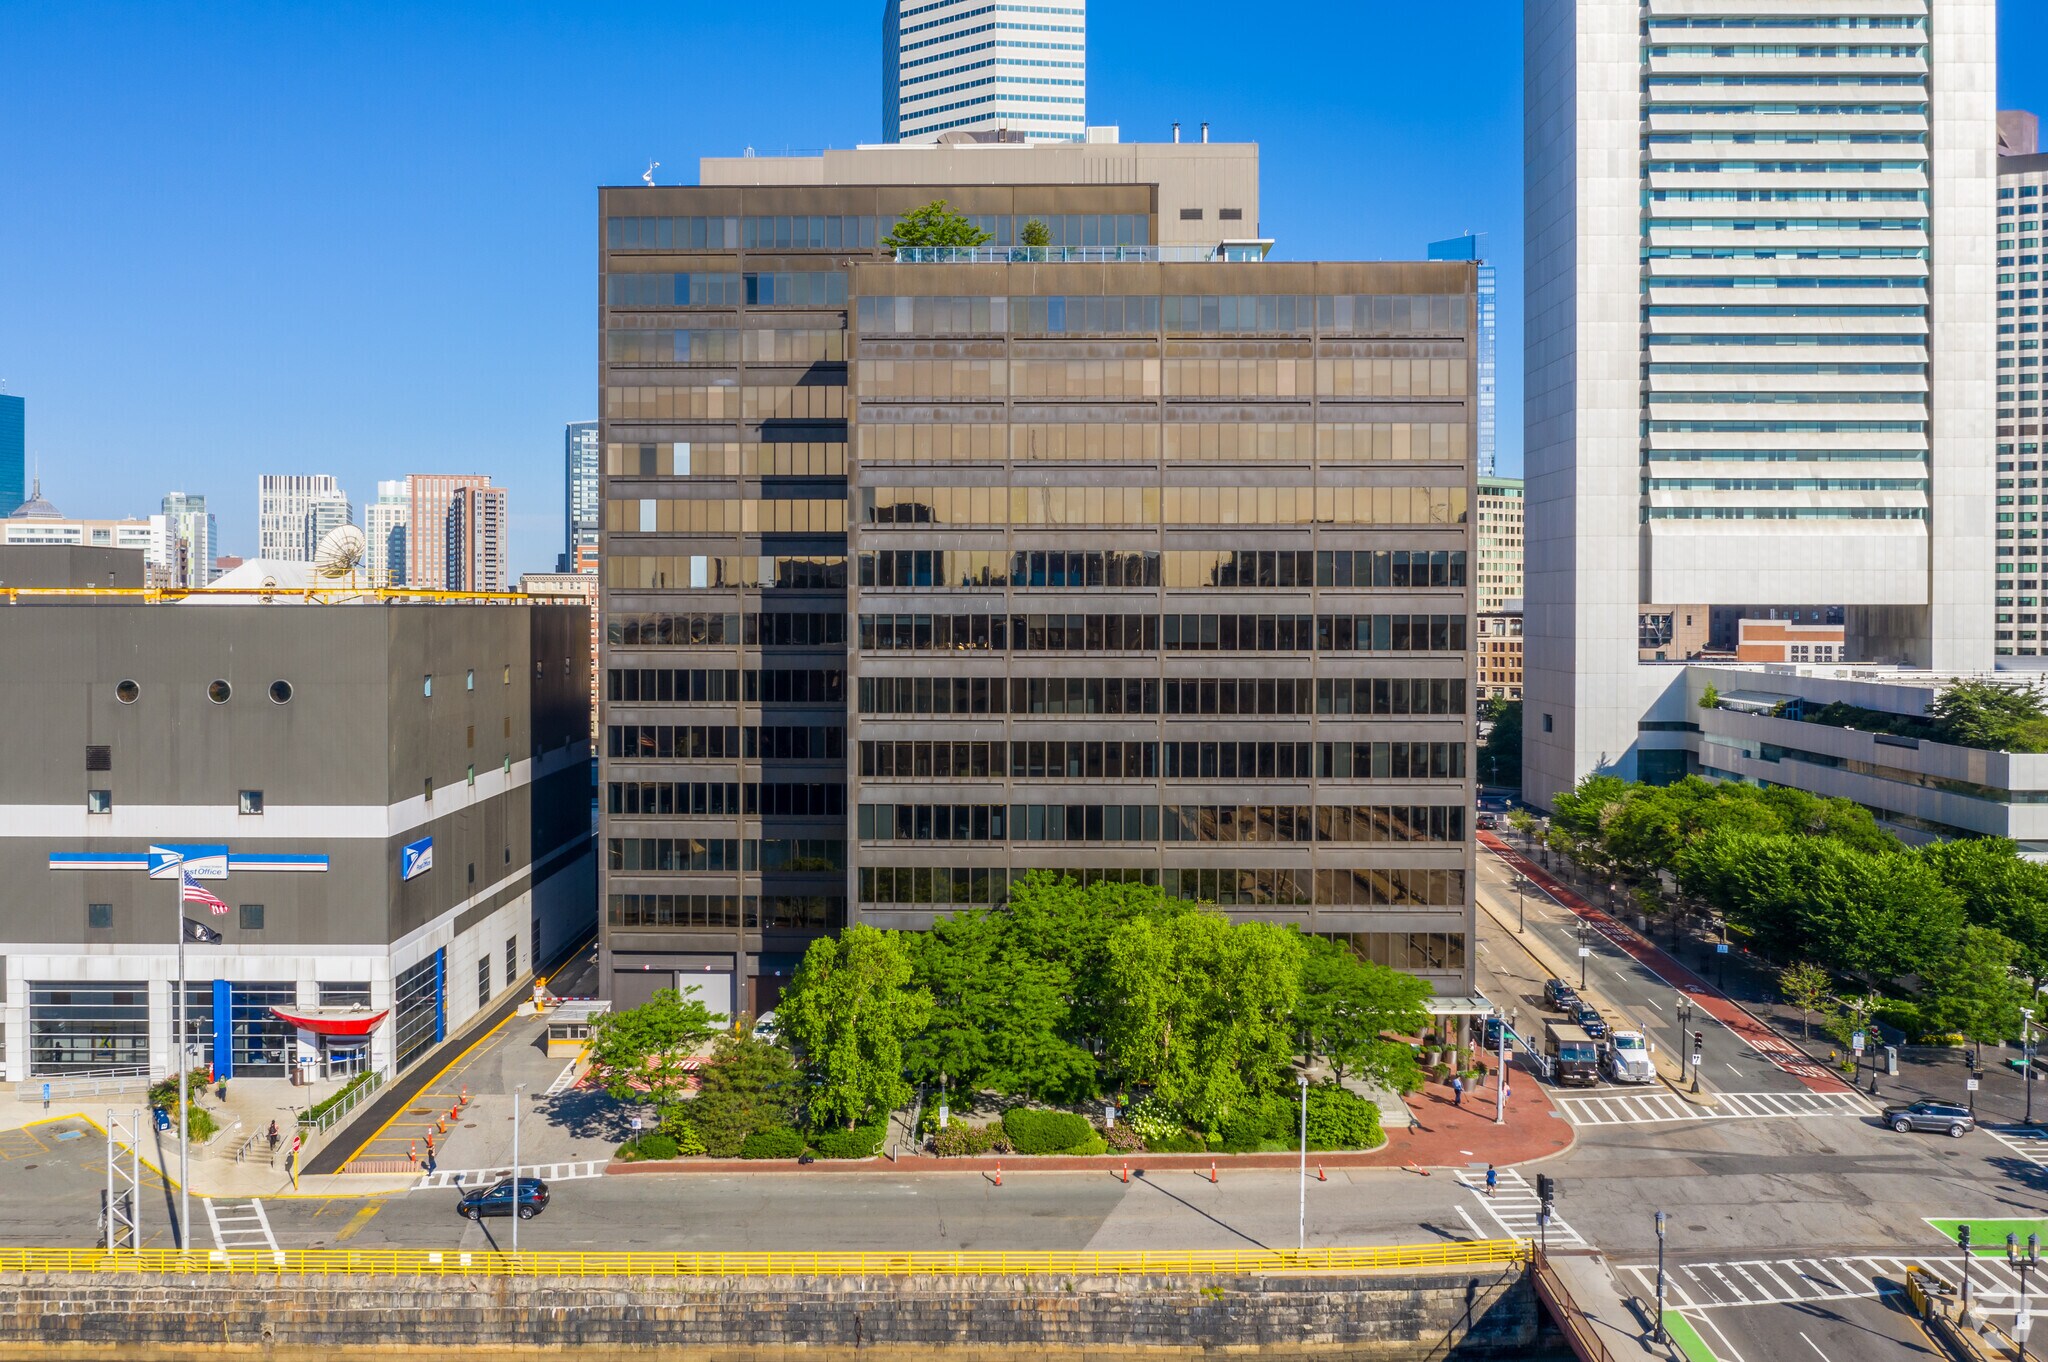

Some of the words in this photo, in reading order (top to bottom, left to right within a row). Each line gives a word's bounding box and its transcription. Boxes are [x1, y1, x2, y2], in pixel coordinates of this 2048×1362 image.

[1751, 1039, 1793, 1051] ONLY
[1770, 1052, 1813, 1064] BIKE
[1789, 1065, 1827, 1077] BUS
